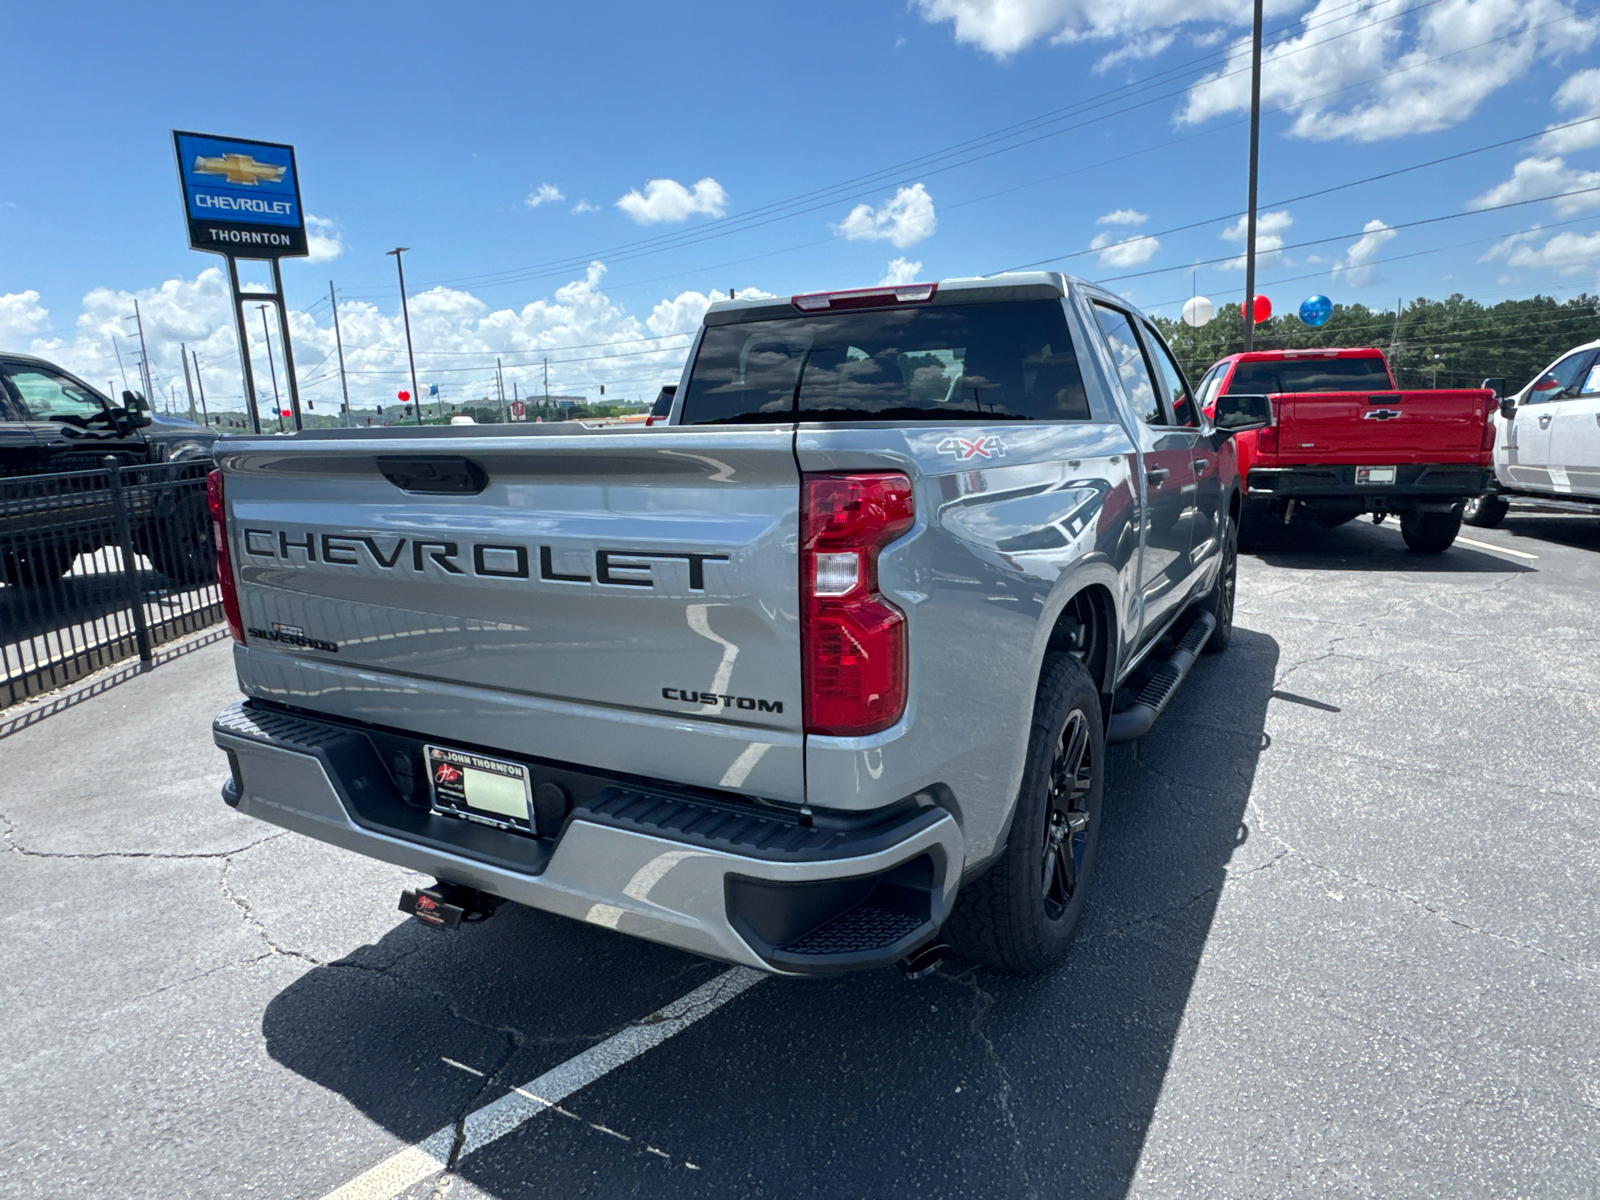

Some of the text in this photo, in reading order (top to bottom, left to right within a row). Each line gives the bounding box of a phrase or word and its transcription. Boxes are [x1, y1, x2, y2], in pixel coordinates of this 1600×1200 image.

[195, 193, 292, 215] CHEVROLET
[209, 228, 291, 246] THORNTON
[244, 527, 730, 592] CHEVROLET
[661, 687, 784, 714] CUSTOM
[447, 751, 523, 777] JOHN THORNTON
